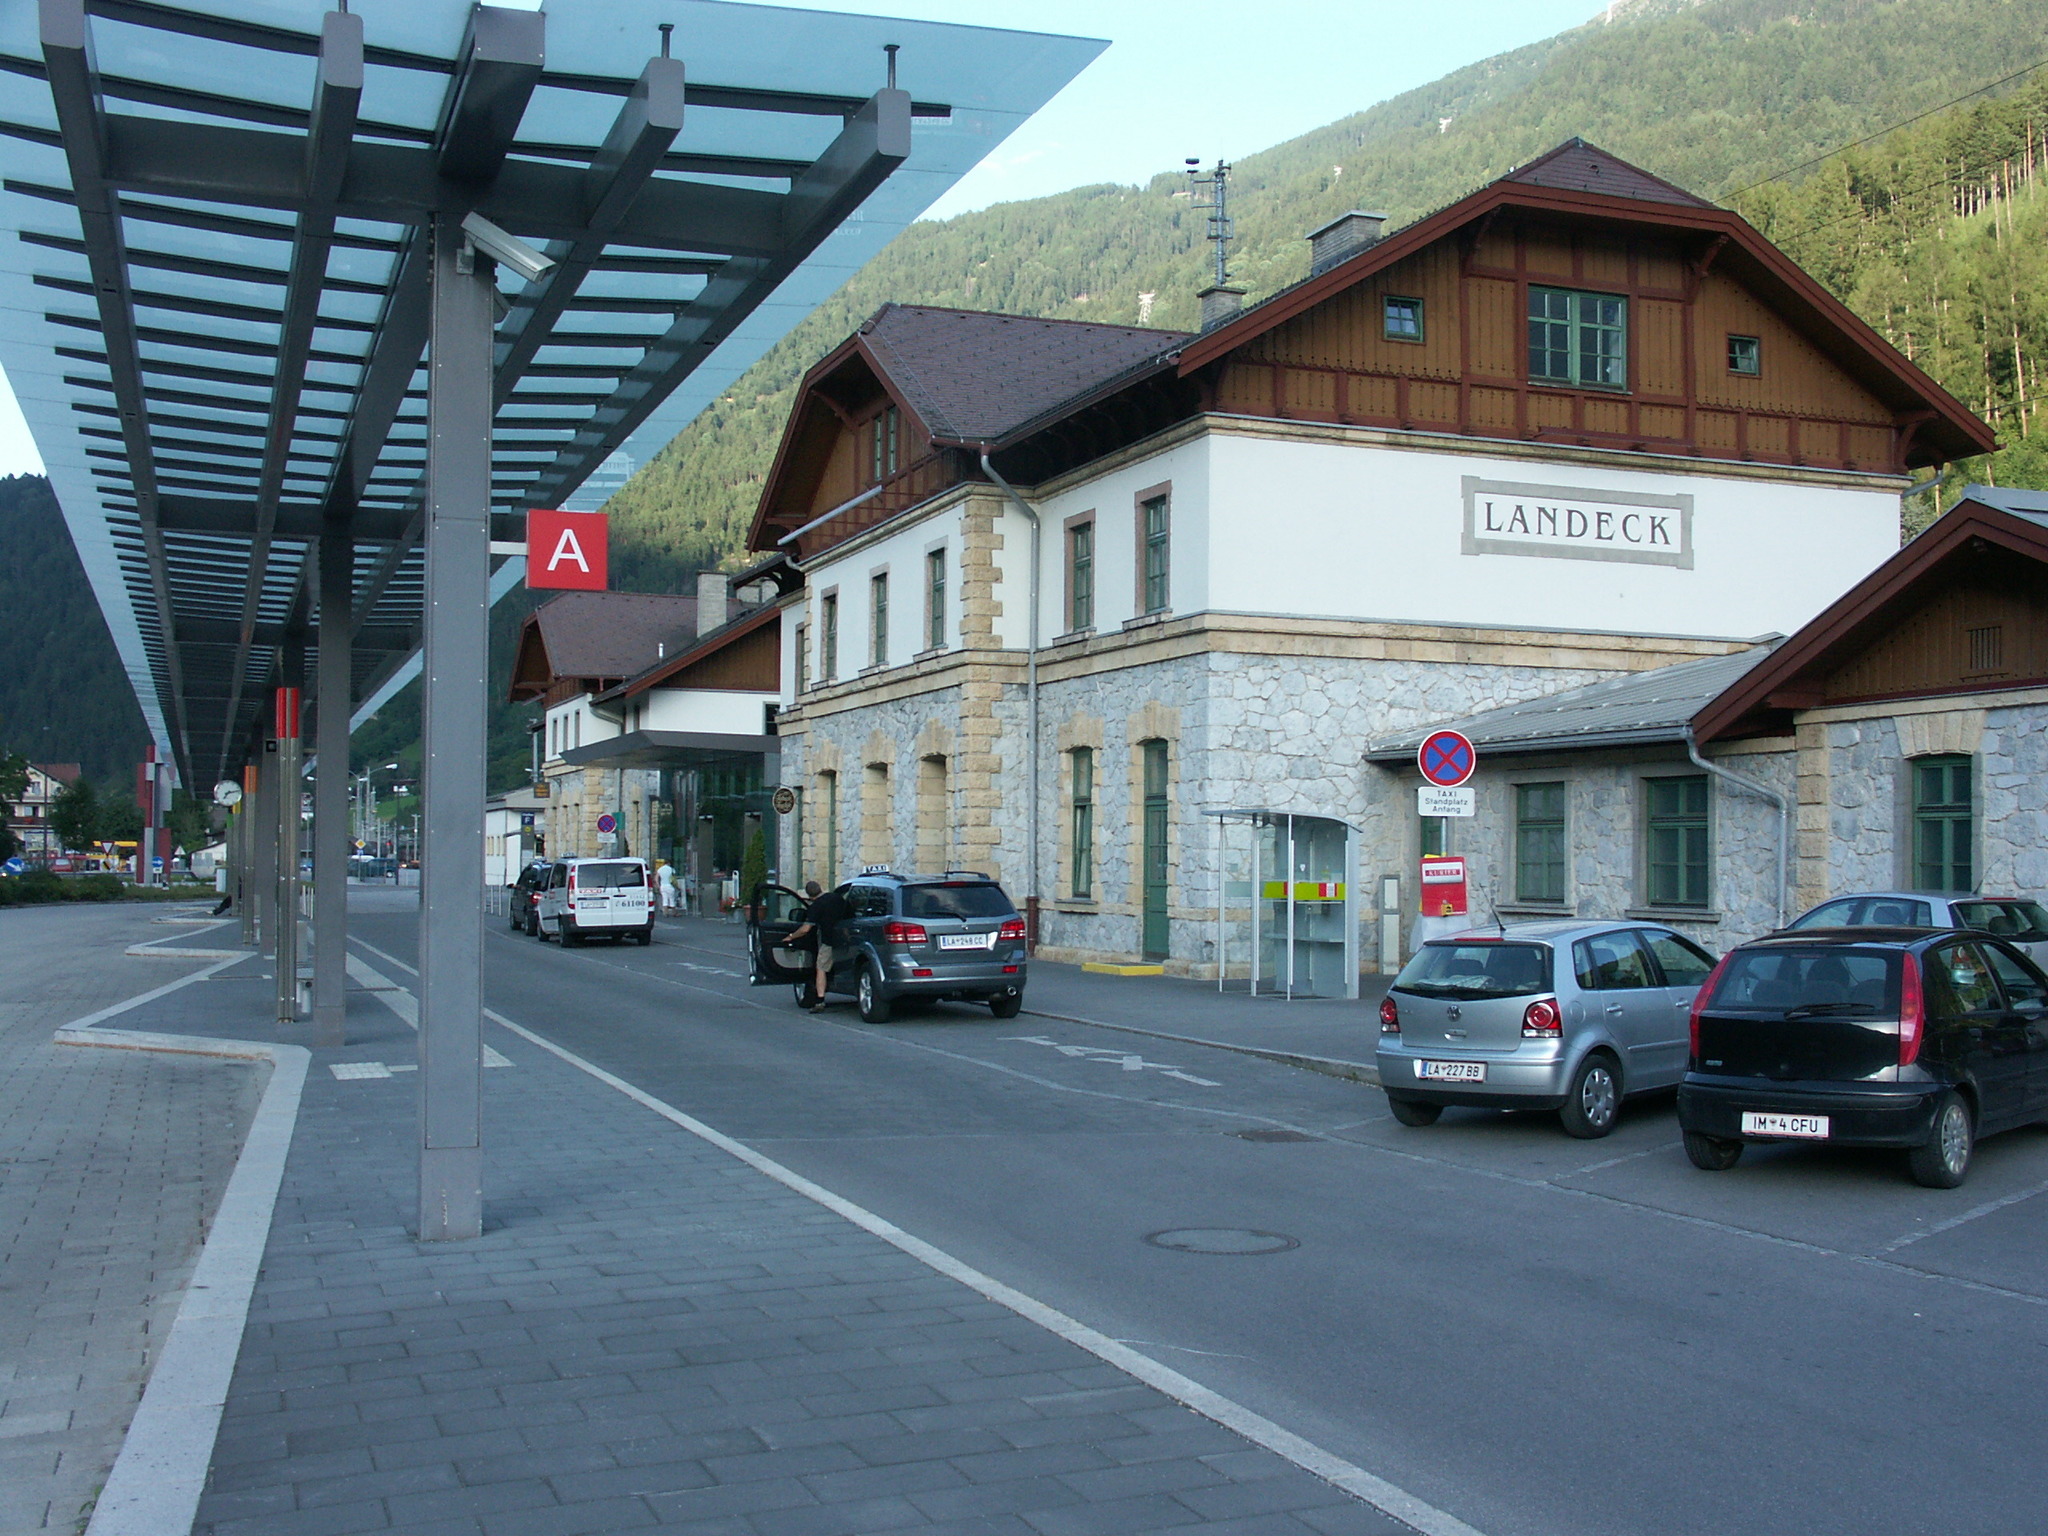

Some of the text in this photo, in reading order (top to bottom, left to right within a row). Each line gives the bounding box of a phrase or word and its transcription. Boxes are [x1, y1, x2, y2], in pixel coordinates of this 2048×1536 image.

[1484, 501, 1672, 546] LANDECK
[546, 528, 590, 573] A
[1424, 797, 1468, 806] Standplatz
[1432, 805, 1461, 814] Anfang
[1428, 1064, 1480, 1077] LA 227 BB
[1753, 1116, 1818, 1133] IM 4 CFU
